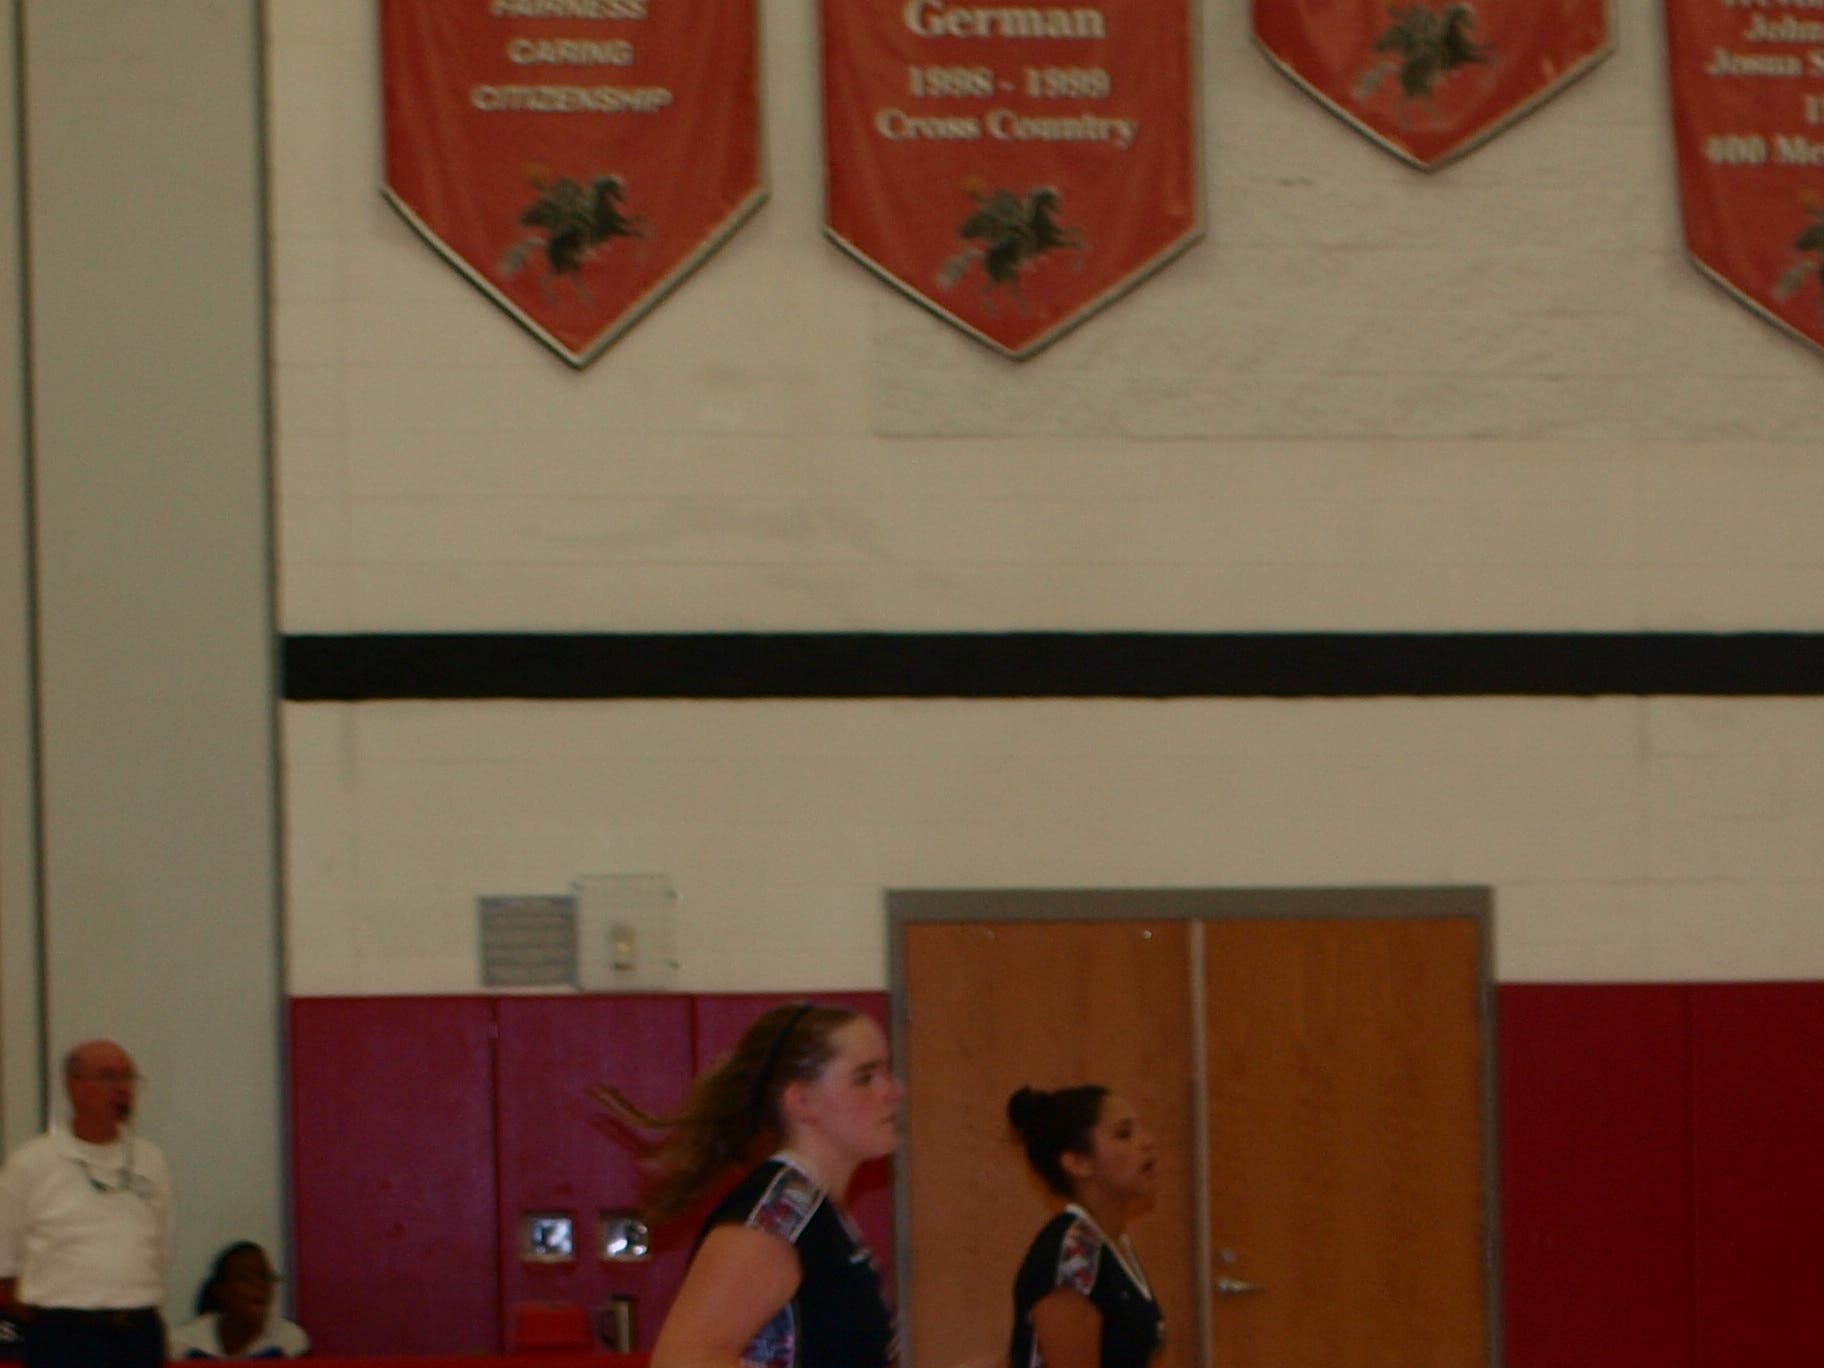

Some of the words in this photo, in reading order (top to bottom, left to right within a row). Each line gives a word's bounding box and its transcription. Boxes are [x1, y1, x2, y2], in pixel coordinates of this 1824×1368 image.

[904, 0, 1106, 38] German
[875, 108, 982, 141] Cross
[985, 108, 1138, 150] Country
